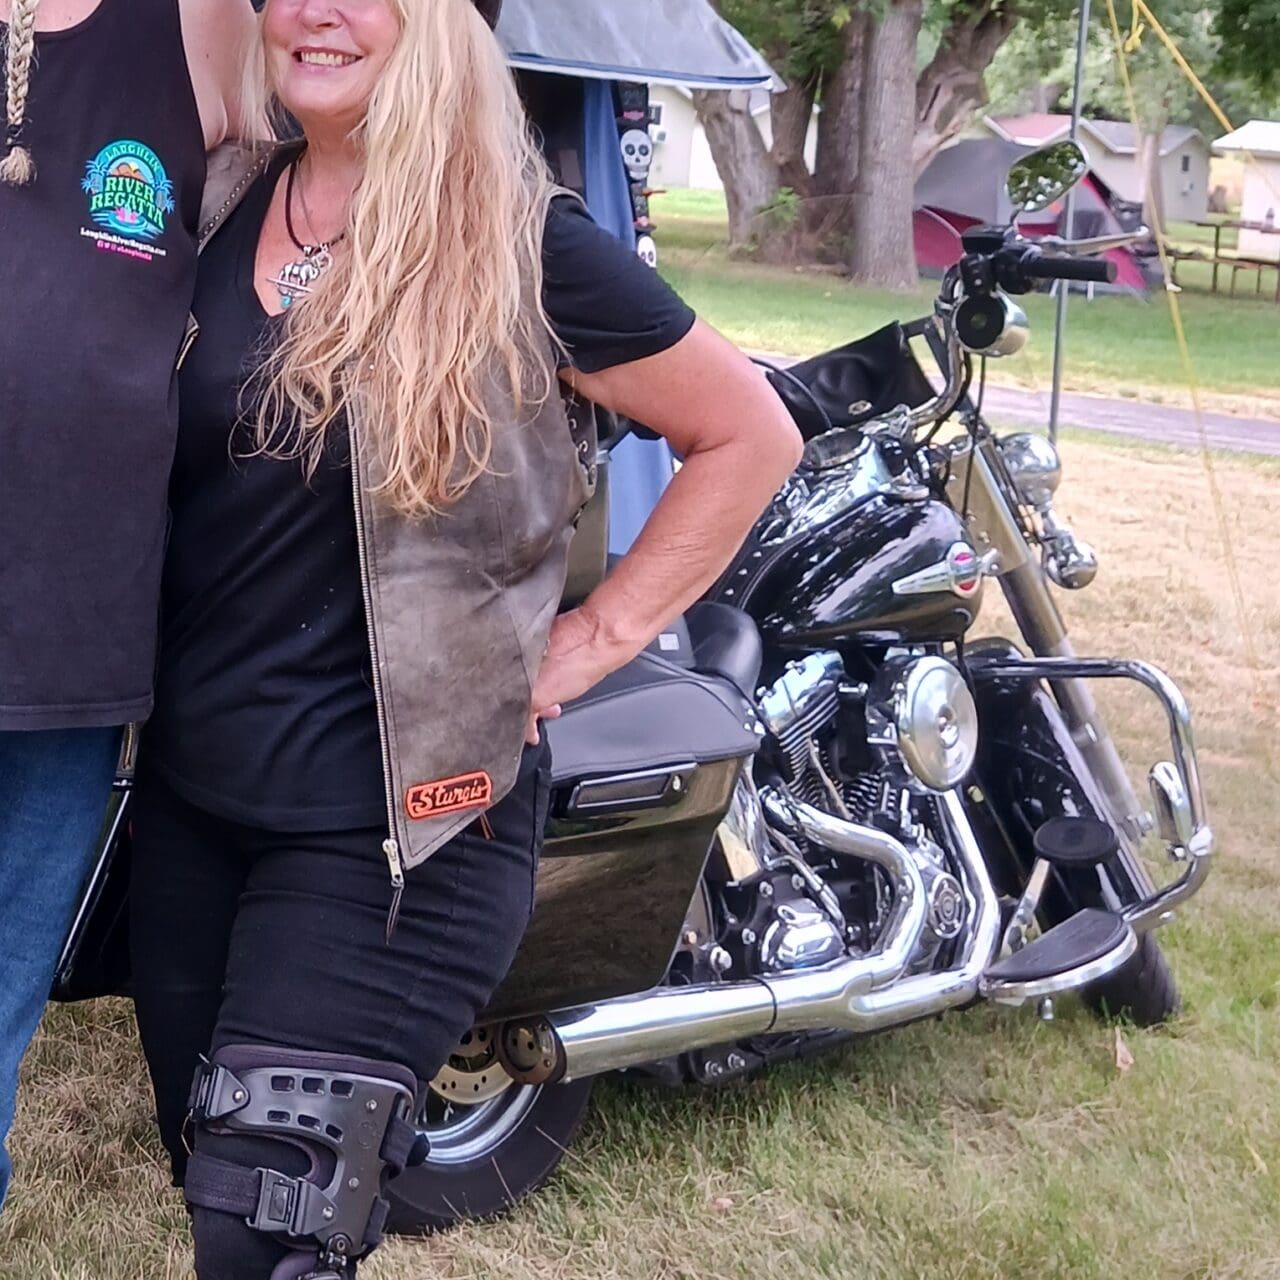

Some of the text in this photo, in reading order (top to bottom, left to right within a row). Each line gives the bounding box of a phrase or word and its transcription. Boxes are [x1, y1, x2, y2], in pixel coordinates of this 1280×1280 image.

[105, 144, 161, 173] LAUGHLIN
[105, 176, 154, 202] RIVER
[90, 192, 164, 230] REGATTA
[411, 779, 488, 813] Sturgis
